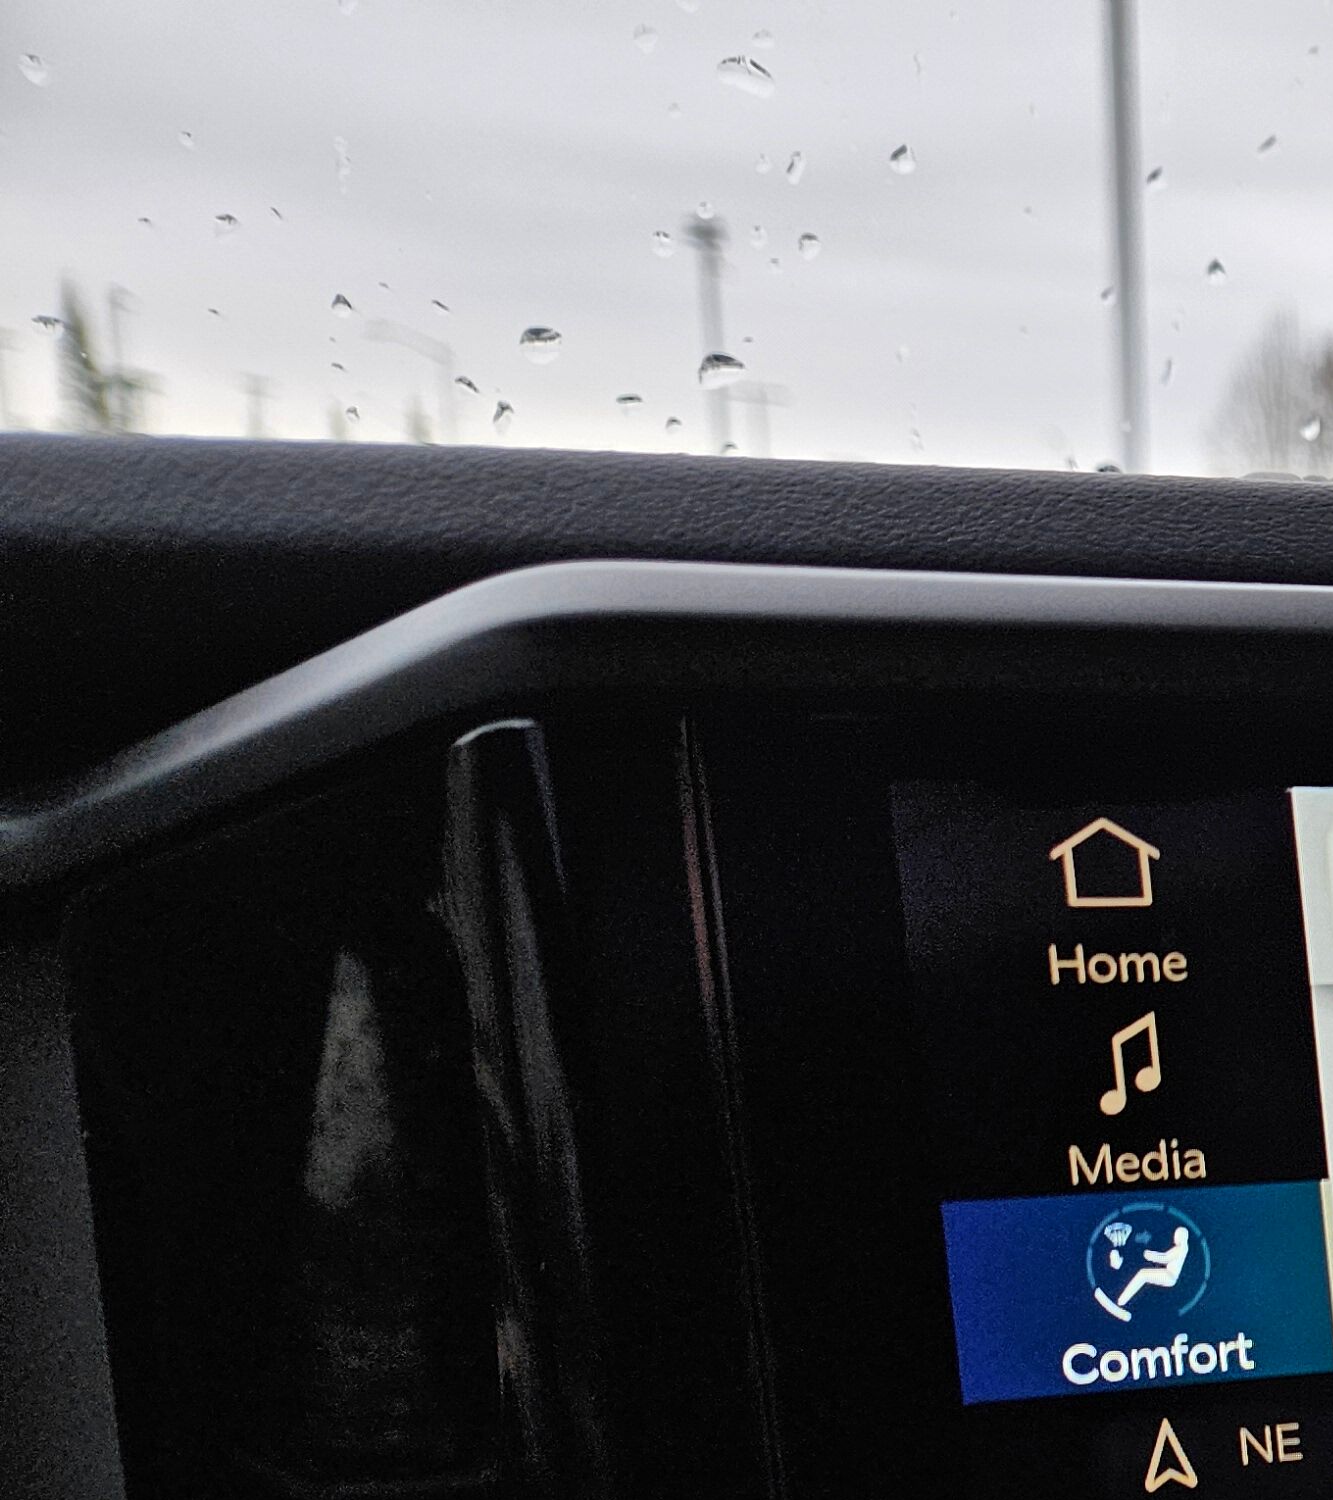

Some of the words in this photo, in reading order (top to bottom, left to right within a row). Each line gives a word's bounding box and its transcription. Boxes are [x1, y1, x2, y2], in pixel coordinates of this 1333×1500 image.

[1048, 943, 1188, 985] Home
[1068, 1138, 1207, 1186] Media
[1062, 1332, 1255, 1385] Comfort
[1239, 1422, 1303, 1466] NE
